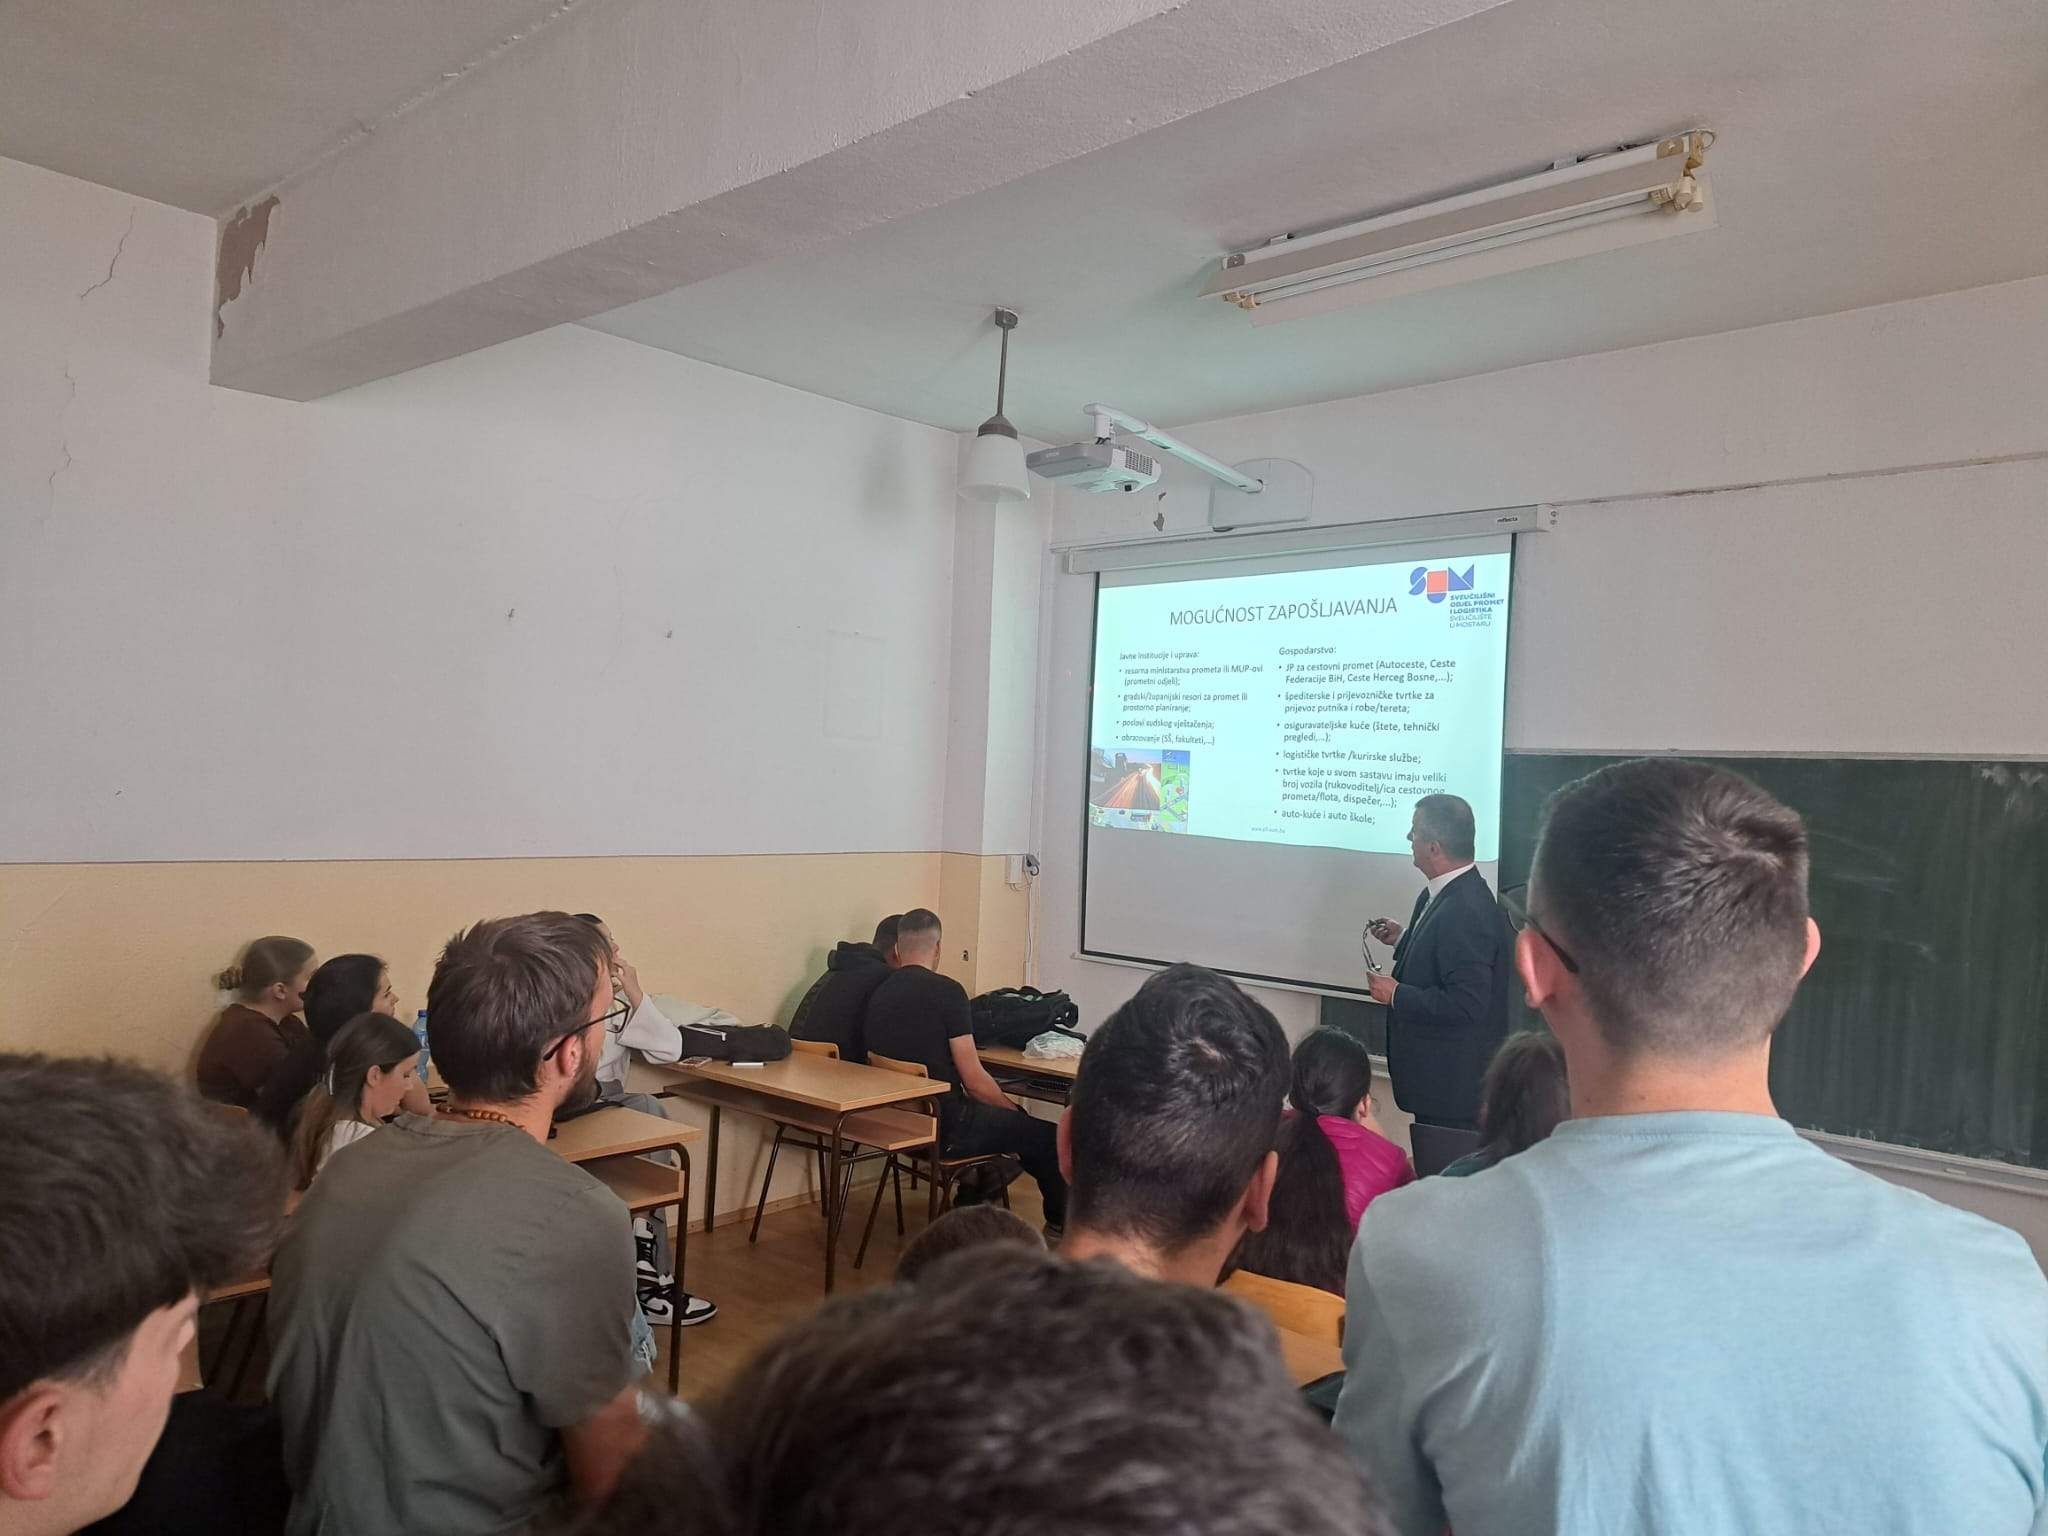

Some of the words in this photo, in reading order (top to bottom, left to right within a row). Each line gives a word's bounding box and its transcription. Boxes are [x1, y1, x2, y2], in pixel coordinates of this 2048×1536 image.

[1450, 592, 1495, 600] SVEUČILIŠNI
[1170, 605, 1264, 625] MOGUĆNOST
[1268, 597, 1398, 621] ZAPOŠLJAVANJA
[1138, 652, 1169, 660] institucije
[1279, 646, 1337, 656] Gospodarstvo:
[1150, 666, 1190, 674] ministarstva
[1192, 666, 1221, 674] prometa
[1286, 664, 1295, 672] JP
[1307, 662, 1340, 671] cestovni
[1342, 662, 1373, 671] promet
[1376, 661, 1427, 670] (Autoceste,
[1430, 659, 1456, 668] Ceste
[1124, 678, 1156, 686] (prometni
[1286, 675, 1326, 685] Federacije
[1328, 675, 1345, 683] BiH,
[1348, 674, 1370, 682] Ceste
[1373, 673, 1405, 683] Herceg
[1213, 693, 1240, 702] promet
[1285, 691, 1331, 701] špediterske
[1337, 690, 1393, 701] prijevozničke
[1396, 691, 1422, 699] tvrtke
[1123, 704, 1154, 712] prostorno
[1156, 704, 1191, 712] planiranje;
[1285, 704, 1316, 713] prijevoz
[1318, 703, 1348, 713] putnika
[1355, 703, 1410, 713] robe/tereta;
[1122, 719, 1144, 727] poslovi
[1146, 719, 1172, 728] sudskog
[1174, 719, 1214, 729] vještačenja;
[1284, 721, 1347, 730] osiguravateljske
[1350, 721, 1370, 730] kuće
[1372, 722, 1401, 732] (štete,
[1403, 722, 1440, 731] tehnički
[1283, 750, 1320, 760] logističke
[1322, 751, 1346, 759] tvrtke
[1348, 750, 1387, 761] /kurirske
[1389, 752, 1421, 764] službe;
[1282, 768, 1306, 776] tvrtke
[1308, 768, 1325, 777] koje
[1334, 769, 1357, 778] svom
[1359, 771, 1392, 780] sastavu
[1395, 772, 1420, 782] imaju
[1422, 773, 1447, 782] veliki
[1282, 779, 1299, 789] broj
[1301, 780, 1323, 789] vozila
[1325, 780, 1396, 794] (rukovoditelj/ica
[1282, 793, 1341, 803] prometa/flota,
[1282, 809, 1321, 819] auto-kuće
[1328, 812, 1347, 820] auto
[1350, 812, 1376, 825] škole;
